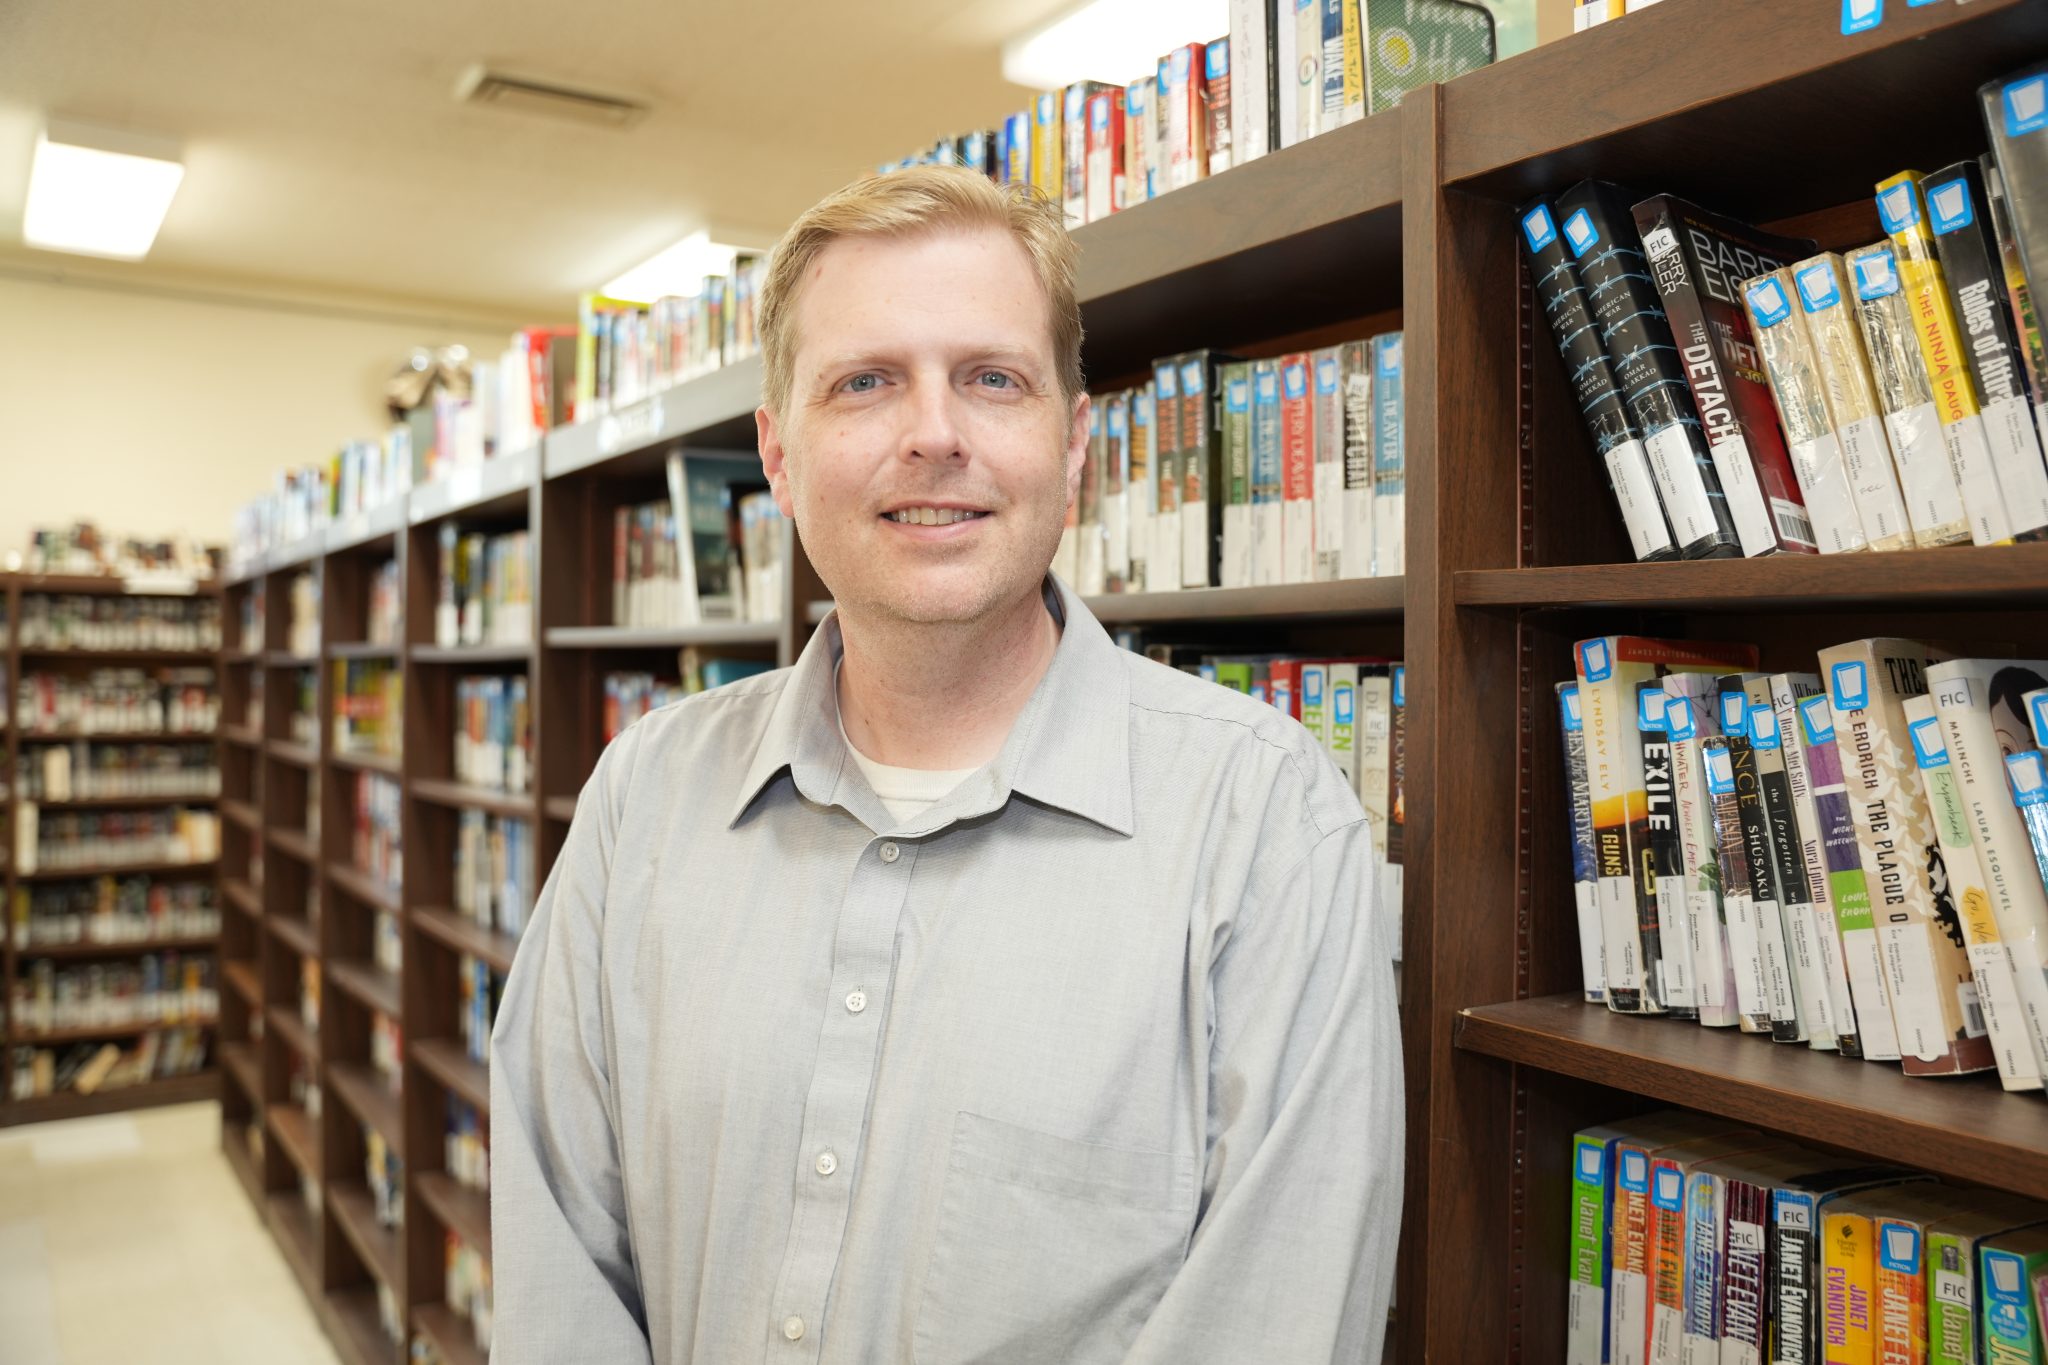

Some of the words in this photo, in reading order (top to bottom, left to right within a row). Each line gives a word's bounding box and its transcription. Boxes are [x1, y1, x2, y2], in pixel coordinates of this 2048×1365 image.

[1649, 235, 1670, 253] FIC
[1941, 218, 1966, 231] FICTION
[1668, 247, 1689, 287] RRY
[1689, 229, 1786, 278] BARR
[1595, 290, 1631, 318] AMERICAN
[1604, 305, 1622, 319] WAR
[1917, 292, 1935, 319] THE
[1958, 277, 1996, 337] Rules
[1559, 318, 1574, 331] WAR
[1688, 320, 1707, 344] THE
[1711, 320, 1733, 335] THE
[1721, 337, 1761, 370] DET
[1925, 322, 1951, 376] NINJA
[1972, 335, 2007, 357] of
[1579, 375, 1598, 391] OMAR
[1584, 378, 1607, 396] AKKAD
[1623, 363, 1646, 380] OMAR
[1630, 367, 1657, 387] AKKAD
[1682, 343, 1735, 446] DETACH
[1942, 379, 1963, 421] DAUG
[1883, 656, 1924, 695] THE
[1940, 692, 1965, 707] FIC
[1591, 688, 1607, 756] LYNDSAY
[1599, 764, 1610, 791] ELY
[1780, 717, 1794, 748] Harry
[1673, 740, 1688, 797] HWATER
[1729, 736, 1759, 808] ENCE
[1786, 748, 1801, 768] Met
[1852, 721, 1880, 790] ERDRICH
[1643, 742, 1671, 831] EXILE
[1770, 788, 1779, 804] the
[1867, 799, 1890, 833] THE
[1948, 720, 1976, 786] MALINCHE
[1972, 801, 1989, 844] LAURA
[1986, 849, 2012, 912] ESQUIVEL
[1601, 833, 1623, 877] GUNS
[1774, 818, 1793, 875] forgotten
[1803, 839, 1819, 865] Nora
[1807, 865, 1827, 904] Ephron
[1874, 839, 1906, 906] PLAGUE
[1889, 912, 1909, 923] O
[1579, 1195, 1599, 1245] Janet
[1627, 1192, 1645, 1225] NET
[1783, 1211, 1805, 1224] FIC
[1656, 1211, 1679, 1255] ANET
[1694, 1218, 1713, 1265] JANET
[1735, 1233, 1754, 1246] FIC
[1577, 1245, 1598, 1288] Evan
[1779, 1233, 1804, 1283] JANET
[1888, 1261, 1912, 1272] FICTION
[1693, 1267, 1712, 1337] EVANOVI
[1824, 1266, 1848, 1346] EVANOVICH
[1848, 1284, 1868, 1331] JANET
[1943, 1283, 1966, 1299] FIC
[1778, 1284, 1807, 1363] EVANOVICH
[1882, 1287, 1910, 1348] JANET
[1938, 1304, 1968, 1360] Janet
